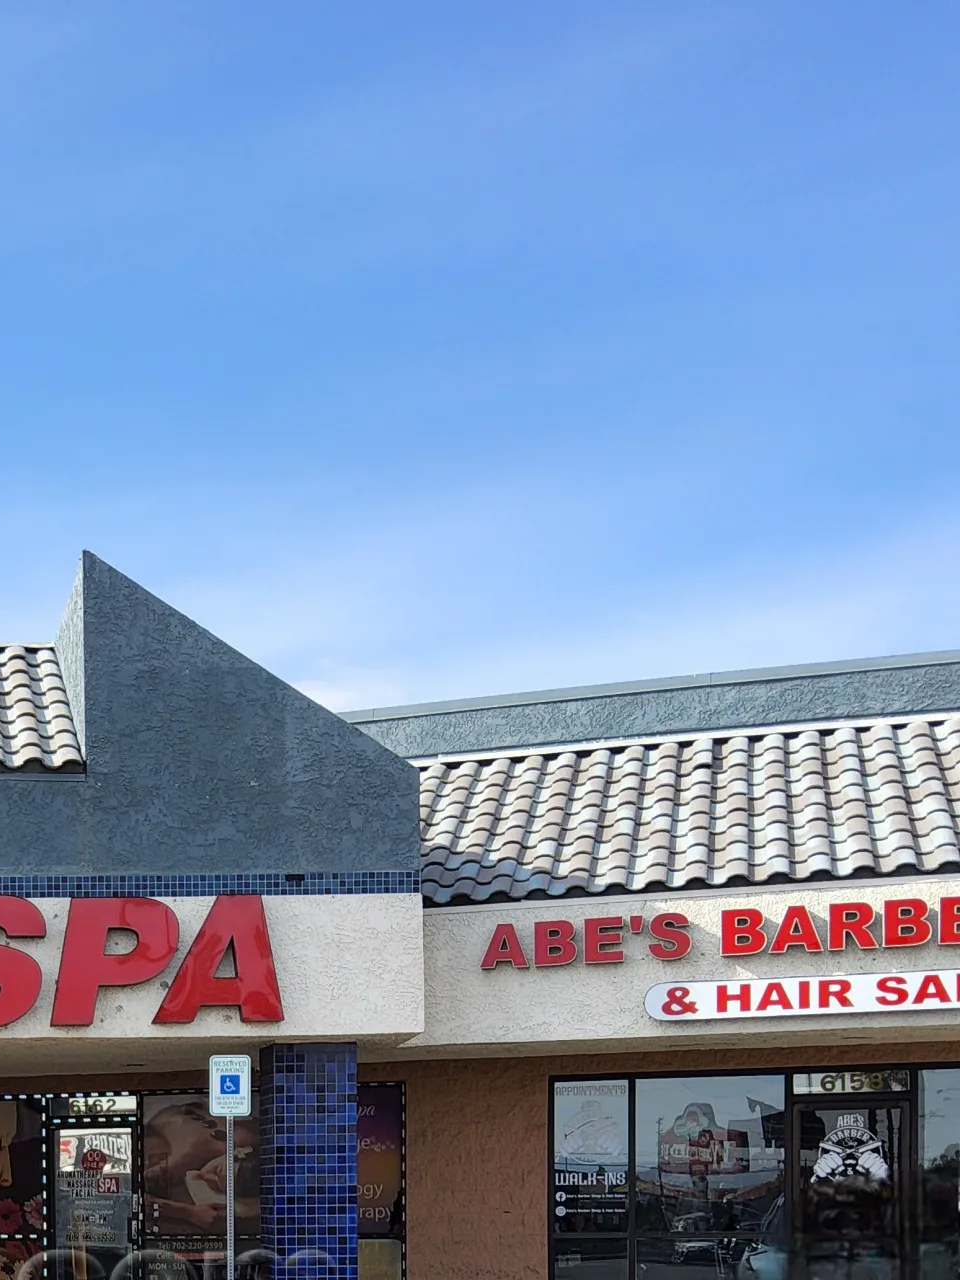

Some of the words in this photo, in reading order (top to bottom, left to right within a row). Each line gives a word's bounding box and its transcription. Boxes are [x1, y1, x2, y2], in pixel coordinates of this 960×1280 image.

[480, 912, 693, 971] ABE'S
[661, 986, 698, 1017] &
[716, 979, 853, 1013] HAIR
[213, 1060, 247, 1068] RESERVED
[555, 1084, 627, 1096] APPOINTMENTS
[820, 1074, 884, 1092] 6158
[69, 1098, 117, 1115] 6162
[836, 1113, 865, 1128] ABE'S
[829, 1129, 871, 1143] BARBER
[56, 1170, 103, 1179] AROMATHERAPY
[554, 1172, 627, 1186] WALK-INS
[67, 1179, 95, 1188] MASSAGE
[98, 1178, 118, 1193] SPA
[71, 1189, 95, 1198] FACIAL
[148, 1262, 167, 1270] MON
